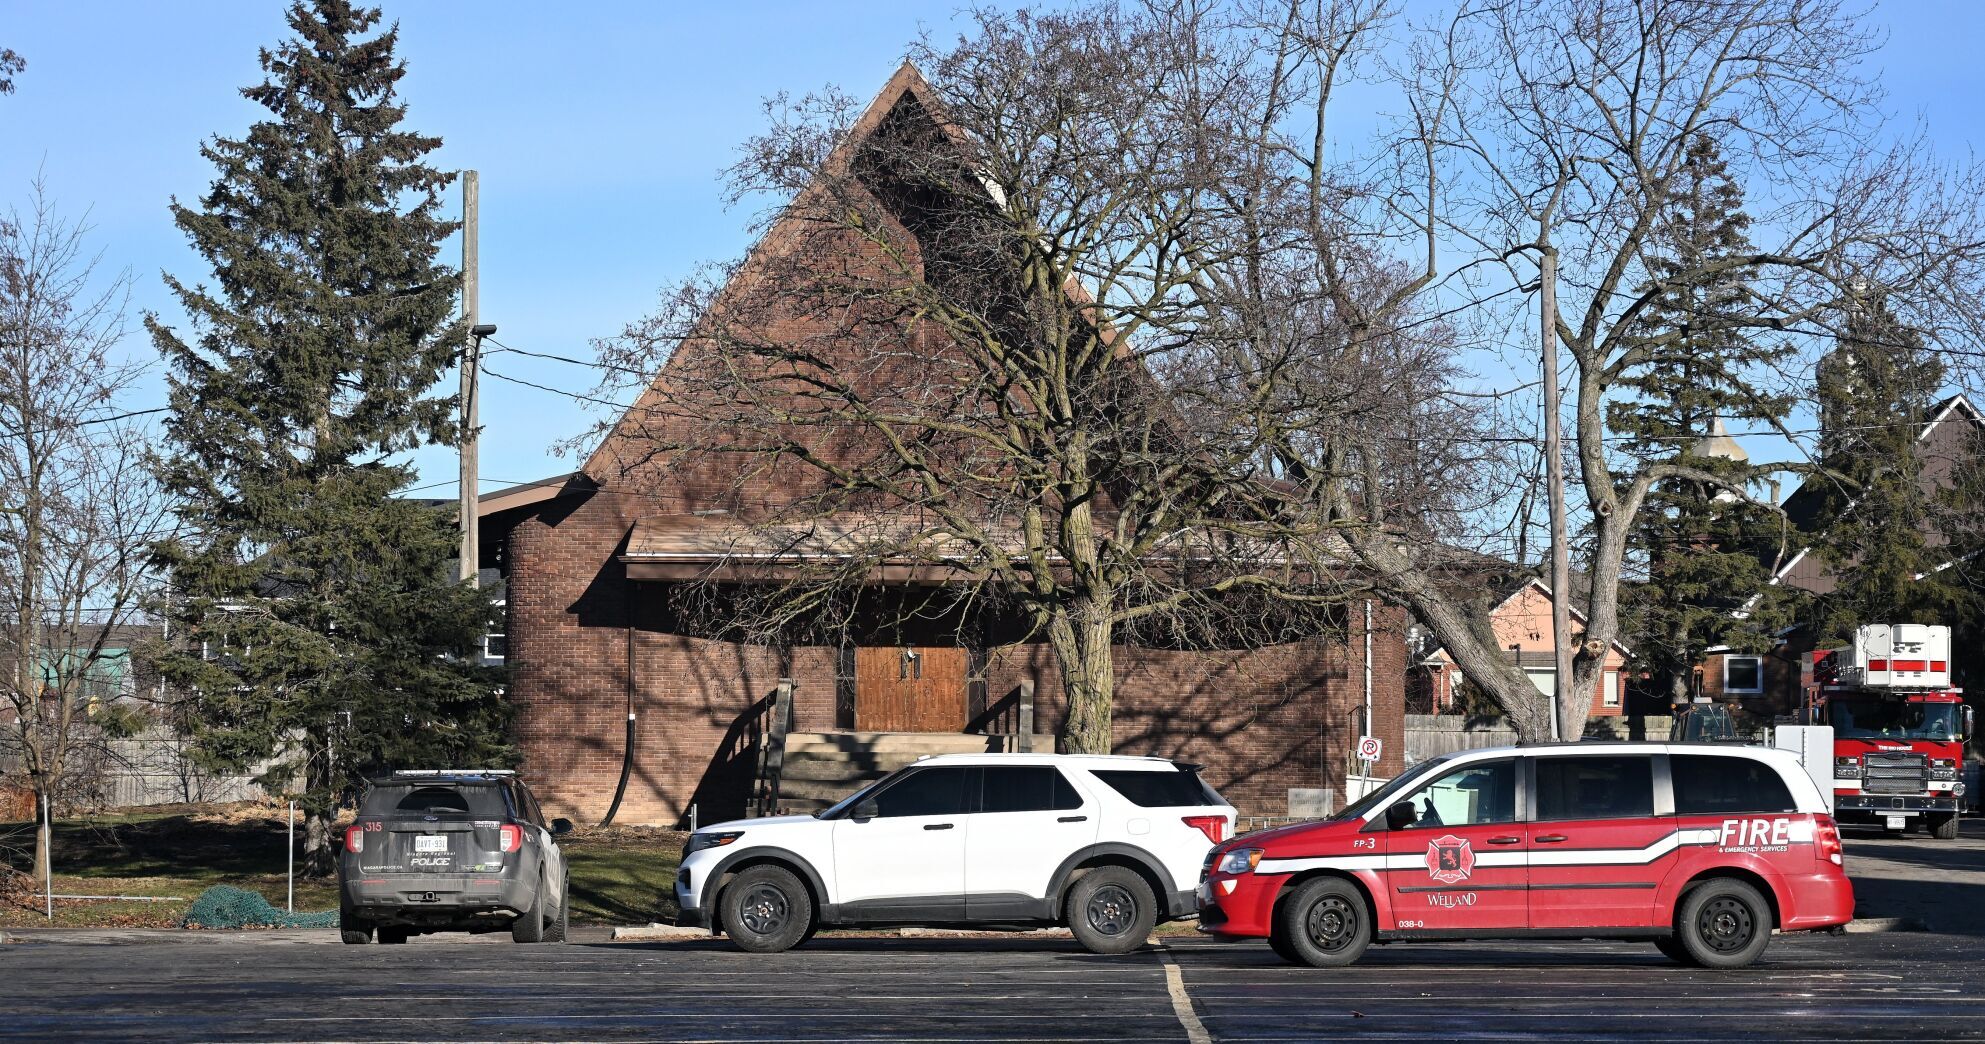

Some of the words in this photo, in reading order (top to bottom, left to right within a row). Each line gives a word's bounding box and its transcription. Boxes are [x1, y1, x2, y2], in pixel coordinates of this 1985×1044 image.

[365, 821, 382, 832] 315
[1720, 818, 1789, 846] FIRE
[1353, 837, 1375, 849] FP-3
[410, 857, 451, 866] POLICE
[1399, 920, 1424, 928] 038-0
